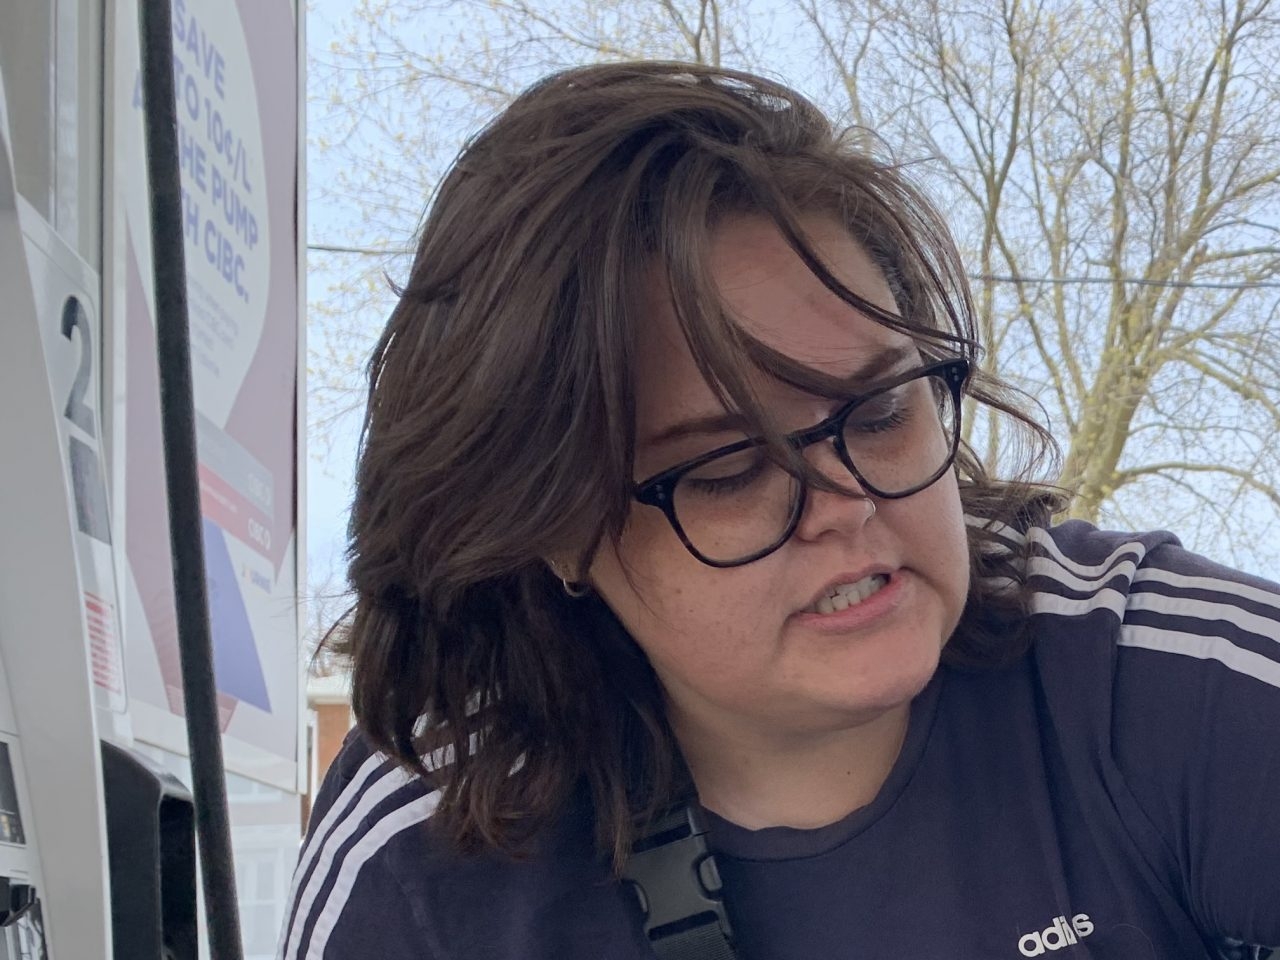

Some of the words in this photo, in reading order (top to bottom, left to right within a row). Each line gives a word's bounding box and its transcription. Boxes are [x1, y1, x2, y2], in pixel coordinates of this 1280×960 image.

[174, 0, 224, 101] SAVE
[211, 163, 259, 251] PUMP
[61, 295, 96, 440] 2
[1018, 913, 1094, 958] adis
